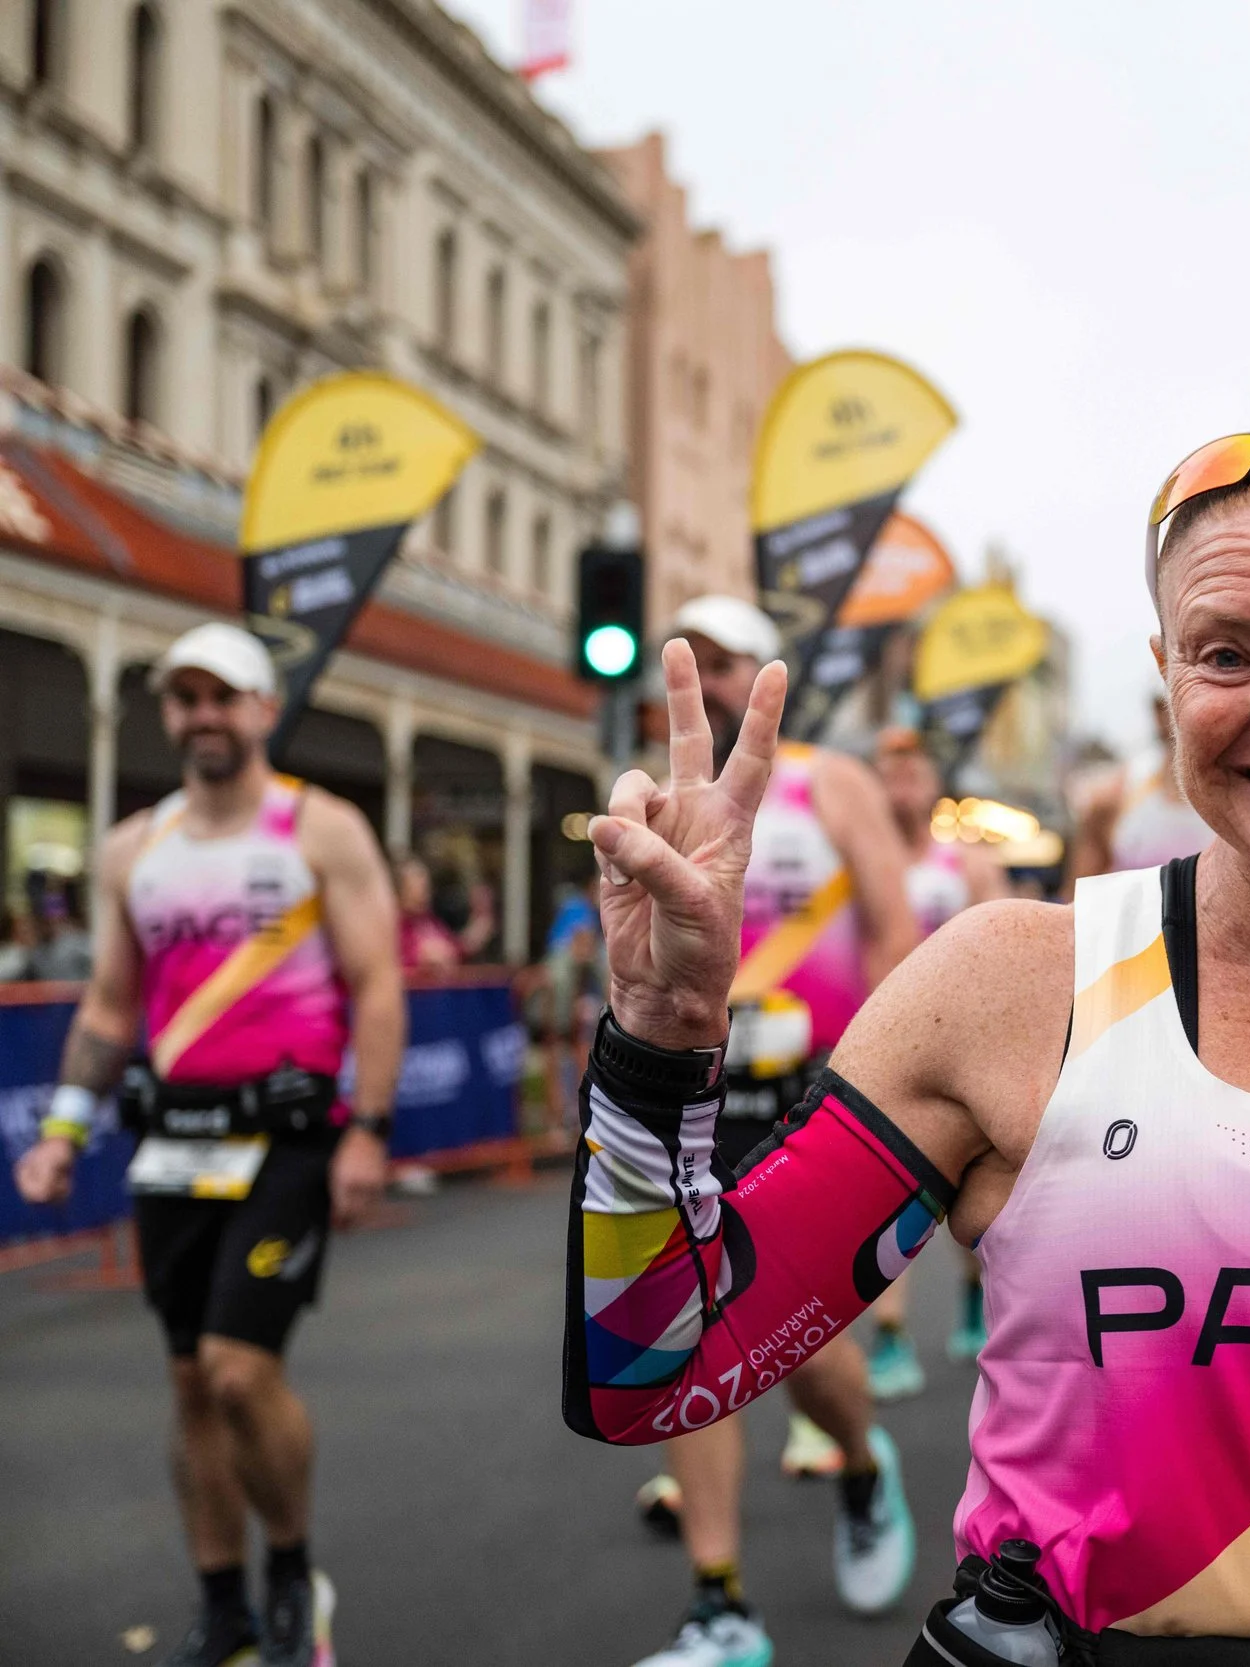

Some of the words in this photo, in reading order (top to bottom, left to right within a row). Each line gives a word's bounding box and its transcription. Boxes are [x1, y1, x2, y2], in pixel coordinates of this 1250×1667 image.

[765, 1154, 789, 1175] March
[738, 1180, 759, 1199] 2024
[749, 1296, 824, 1370] MARATHO
